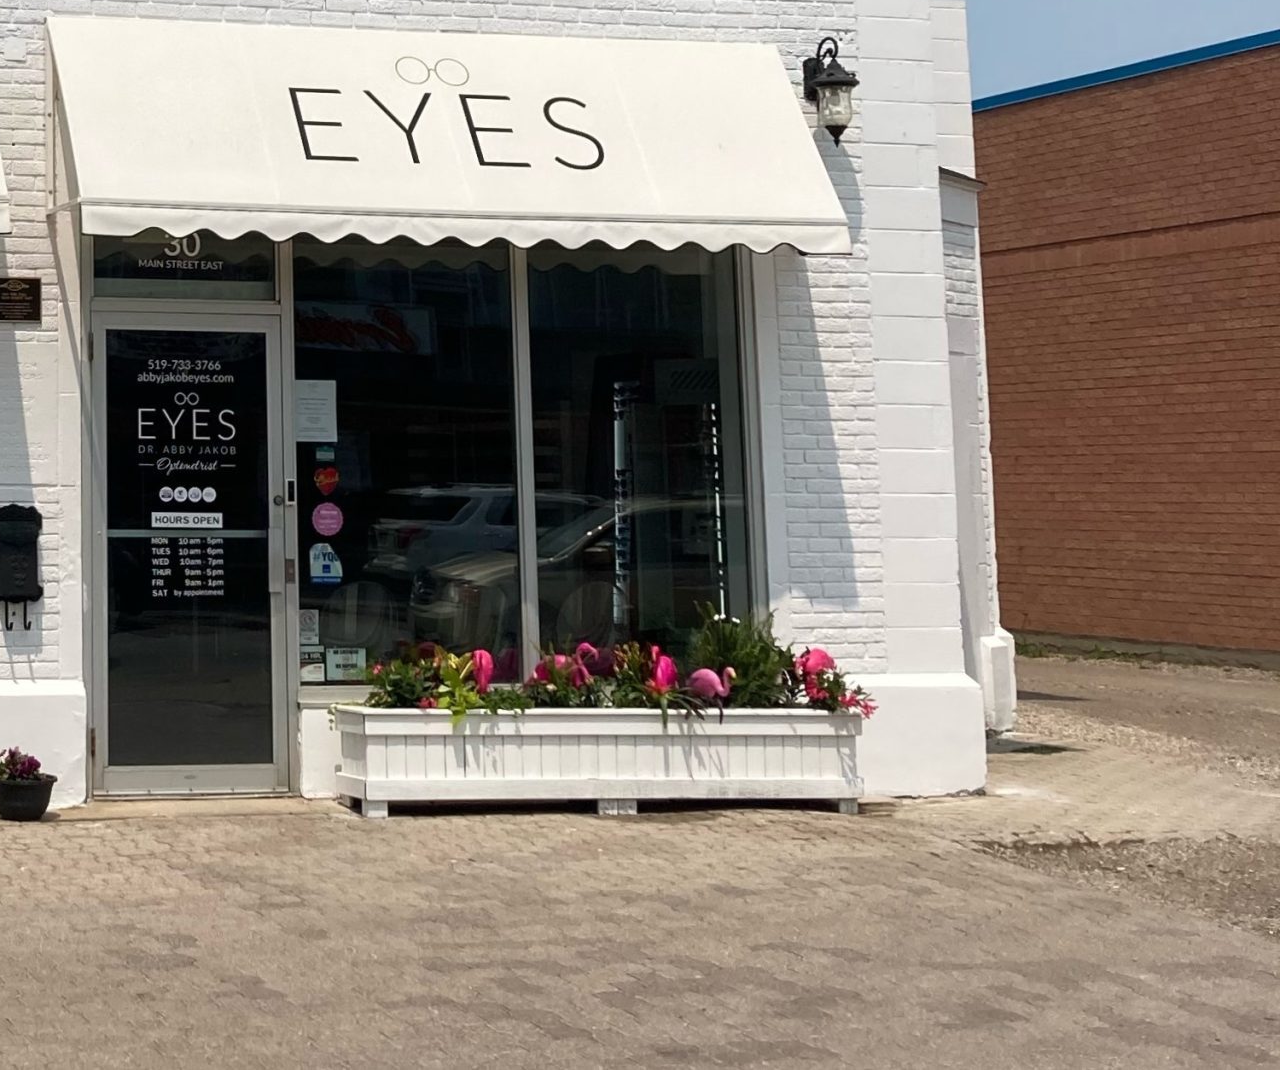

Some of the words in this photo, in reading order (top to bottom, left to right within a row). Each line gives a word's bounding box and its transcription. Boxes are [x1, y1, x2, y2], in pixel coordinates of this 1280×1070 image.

[288, 87, 605, 170] EYES
[164, 233, 200, 256] 30
[138, 259, 164, 268] MAIN
[165, 260, 199, 269] STREET
[201, 261, 224, 270] EAST
[147, 359, 221, 370] 519-733-3766
[137, 371, 234, 384] abbyjakobeyes.com
[138, 408, 236, 441] EYES
[163, 445, 193, 455] ABBY
[198, 445, 237, 455] JAKOB
[154, 516, 190, 525] HOURS
[192, 516, 220, 525] OPEN
[151, 536, 168, 544] MON
[151, 547, 171, 555] TUES
[152, 558, 170, 566] WED
[152, 568, 172, 576] THUR
[151, 579, 164, 587] FRI
[152, 589, 168, 597] SAT
[173, 590, 182, 598] by
[183, 589, 224, 597] appointment
